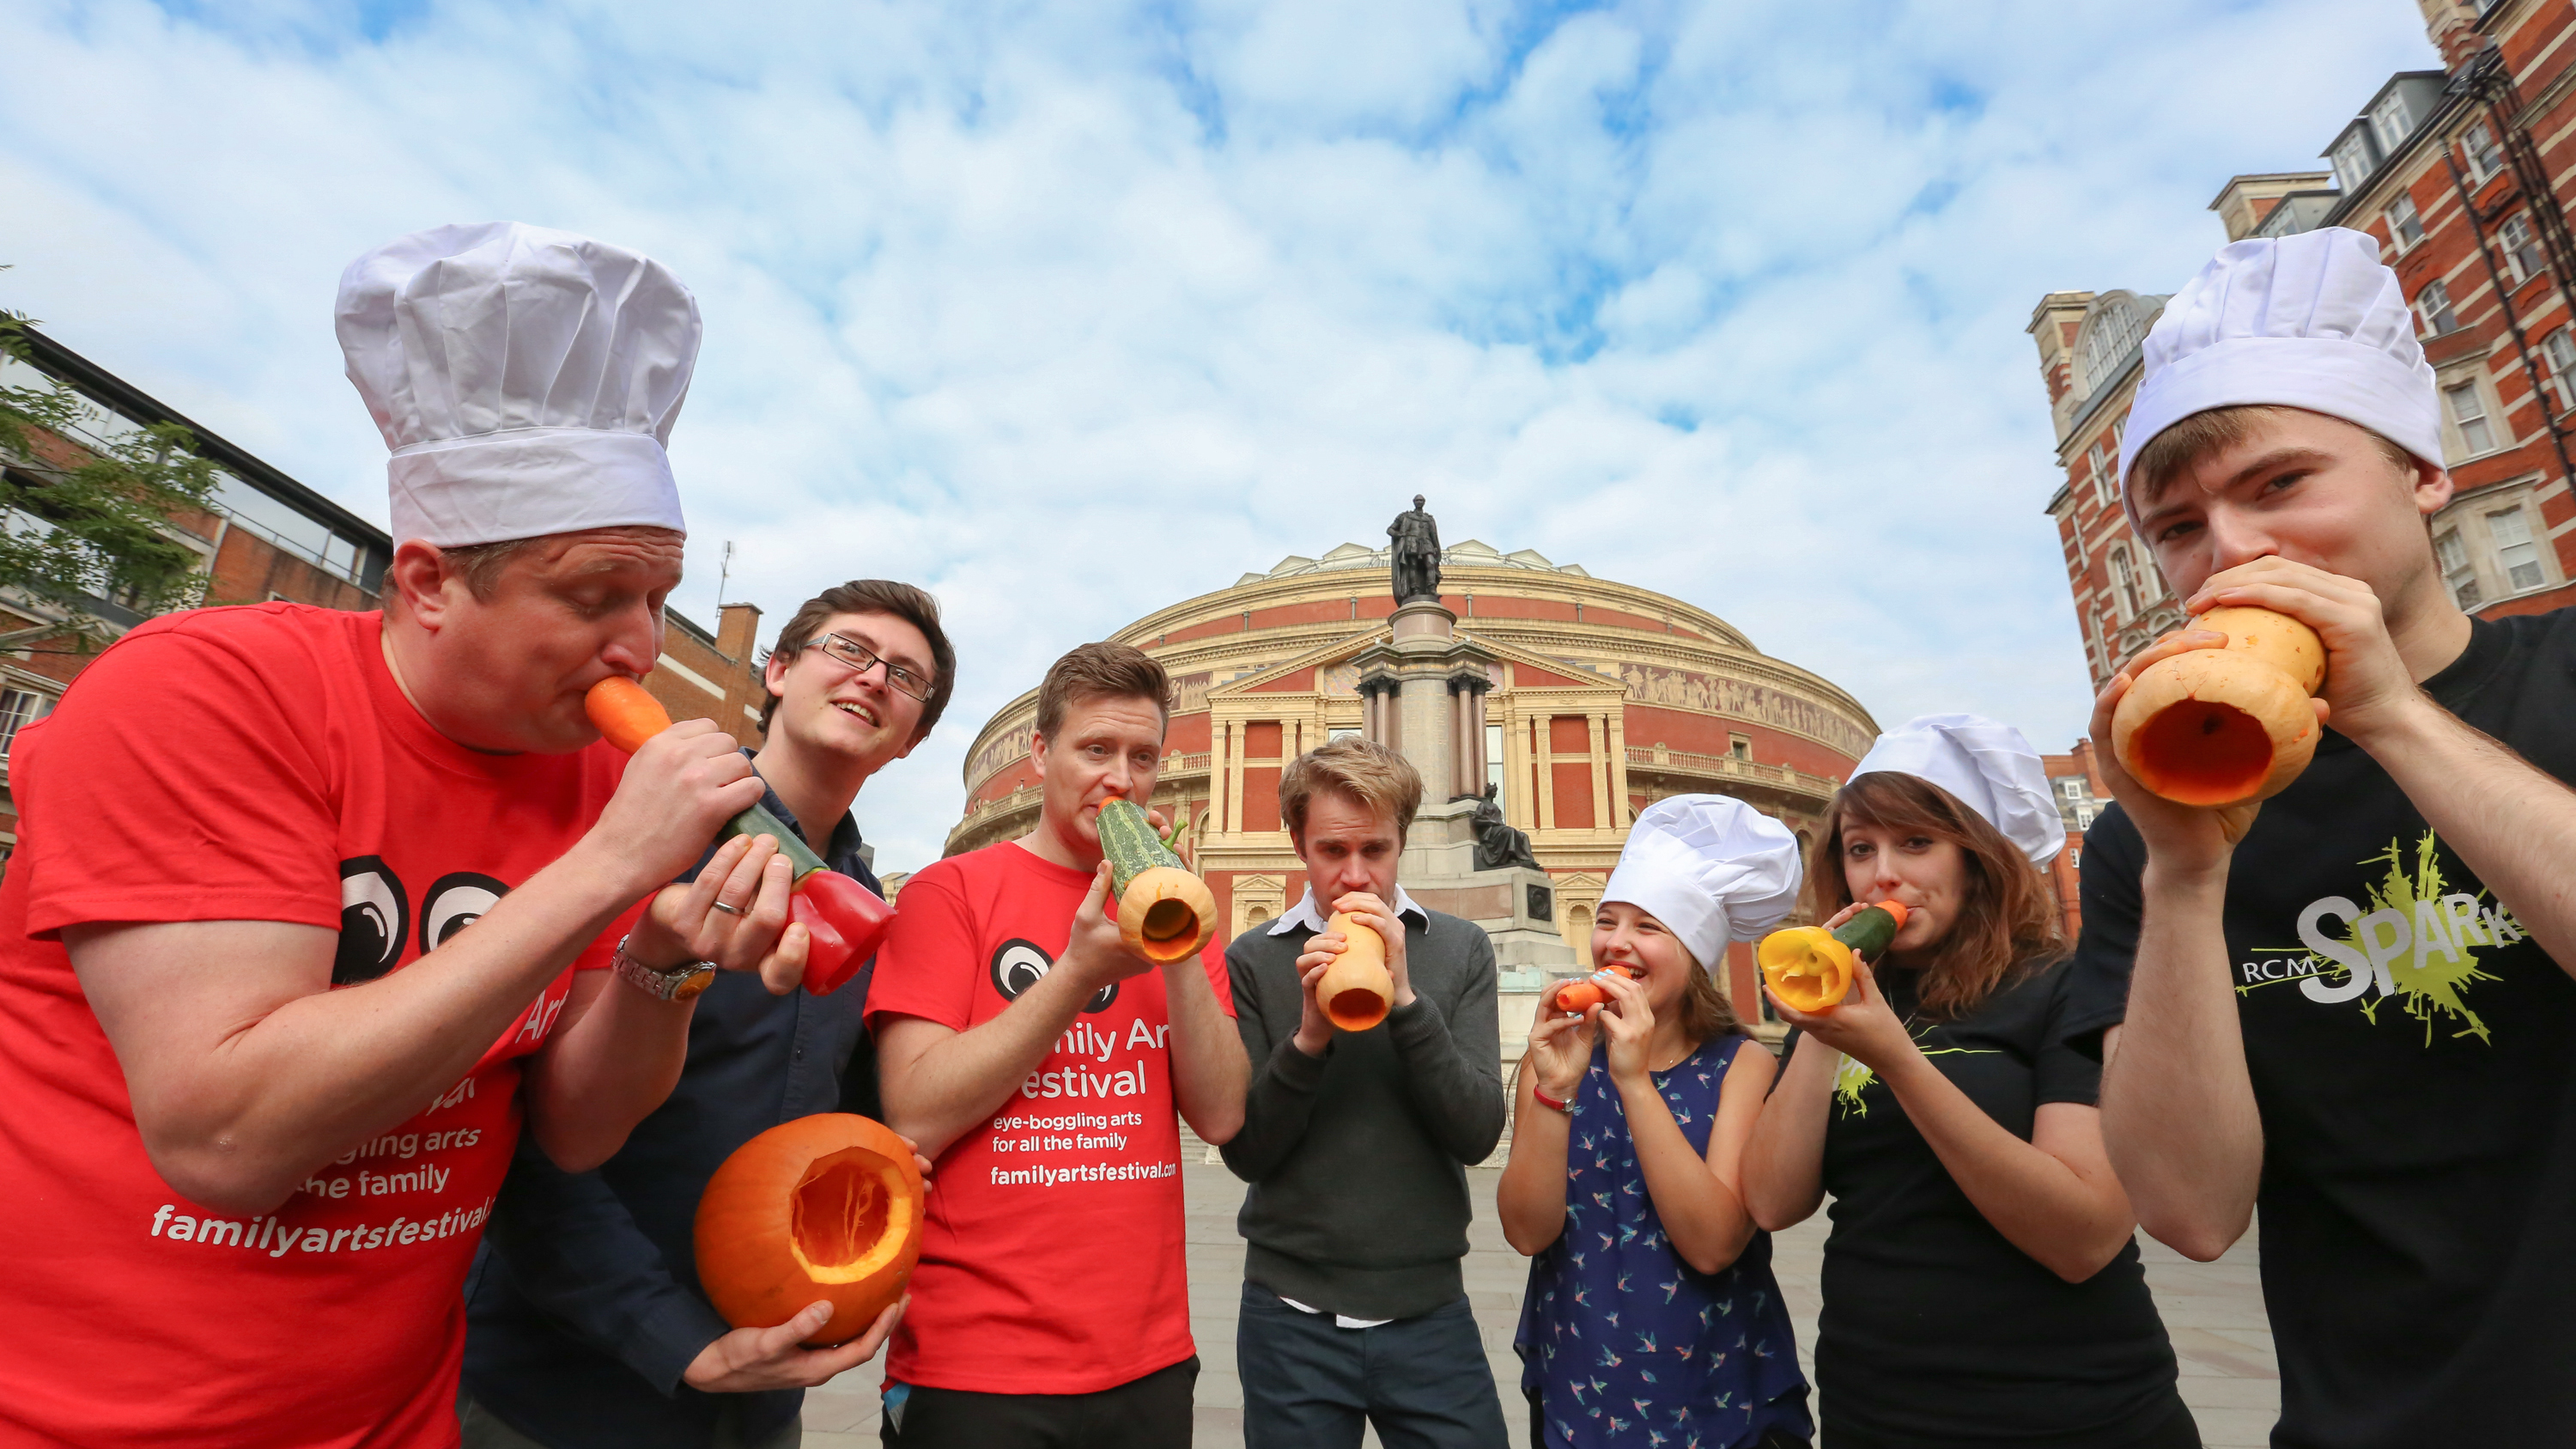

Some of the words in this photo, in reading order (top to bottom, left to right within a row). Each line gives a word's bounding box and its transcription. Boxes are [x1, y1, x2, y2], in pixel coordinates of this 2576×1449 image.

[2242, 955, 2318, 983] RCM
[2296, 892, 2523, 1005] SPARK
[1021, 1059, 1146, 1099] estival
[993, 1111, 1108, 1133] eye-boggling
[1110, 1111, 1143, 1127] arts
[424, 1128, 482, 1151] arts
[992, 1135, 1017, 1153] for
[1018, 1135, 1041, 1152] all
[1042, 1135, 1073, 1152] the
[1075, 1131, 1128, 1151] family
[296, 1176, 350, 1199] he
[358, 1163, 451, 1196] family
